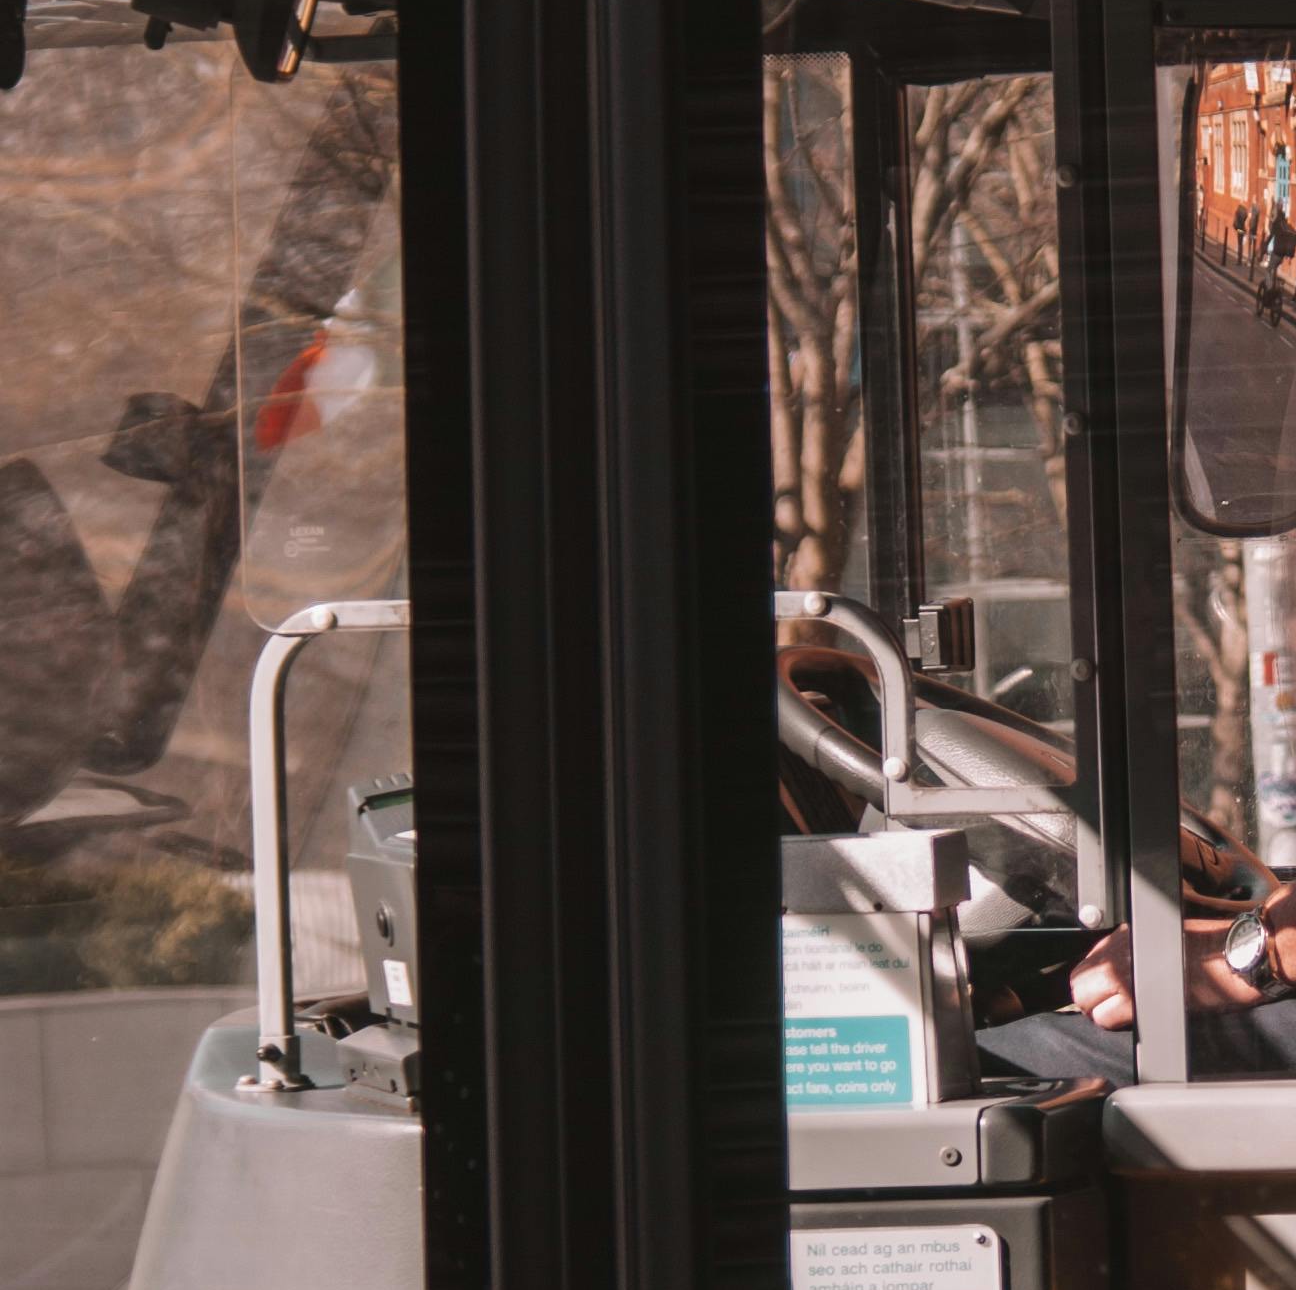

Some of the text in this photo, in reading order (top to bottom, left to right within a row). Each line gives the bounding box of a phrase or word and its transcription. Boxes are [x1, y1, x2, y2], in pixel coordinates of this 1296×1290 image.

[868, 941, 883, 953] do
[785, 1027, 837, 1039] stomers
[785, 1041, 888, 1056] ase tell the driver
[807, 1061, 829, 1076] you
[832, 1060, 862, 1072] want
[864, 1059, 877, 1071] to
[880, 1059, 897, 1074] go
[835, 1081, 867, 1093] coins
[871, 1079, 896, 1095] only
[831, 1243, 868, 1257] cead
[873, 1243, 893, 1259] ag
[897, 1243, 915, 1255] an
[921, 1240, 961, 1254] mbus
[808, 1265, 835, 1277] seo
[840, 1261, 868, 1276] ach
[872, 1260, 923, 1275] cathair
